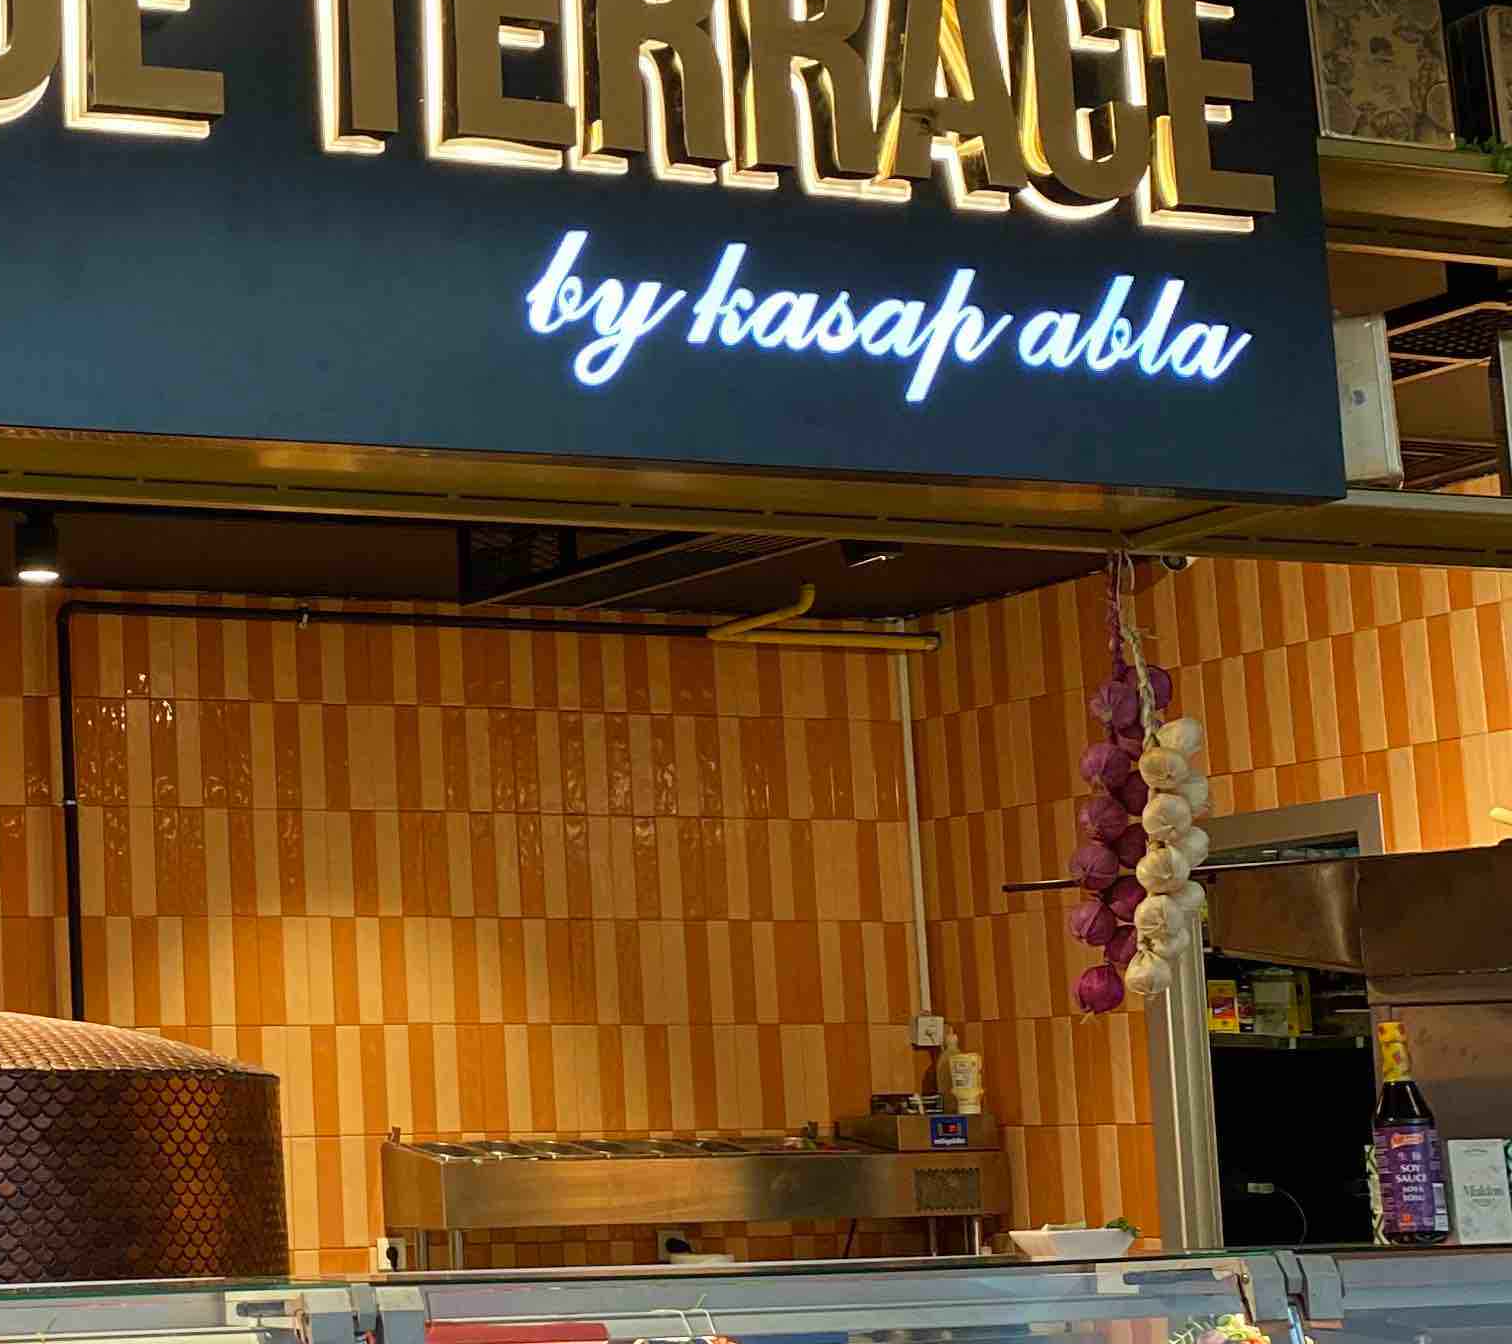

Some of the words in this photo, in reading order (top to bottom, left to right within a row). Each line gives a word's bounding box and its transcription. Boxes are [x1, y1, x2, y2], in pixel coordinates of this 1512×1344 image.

[527, 230, 687, 387] by
[687, 242, 1014, 403] kasap
[1017, 274, 1254, 381] abla
